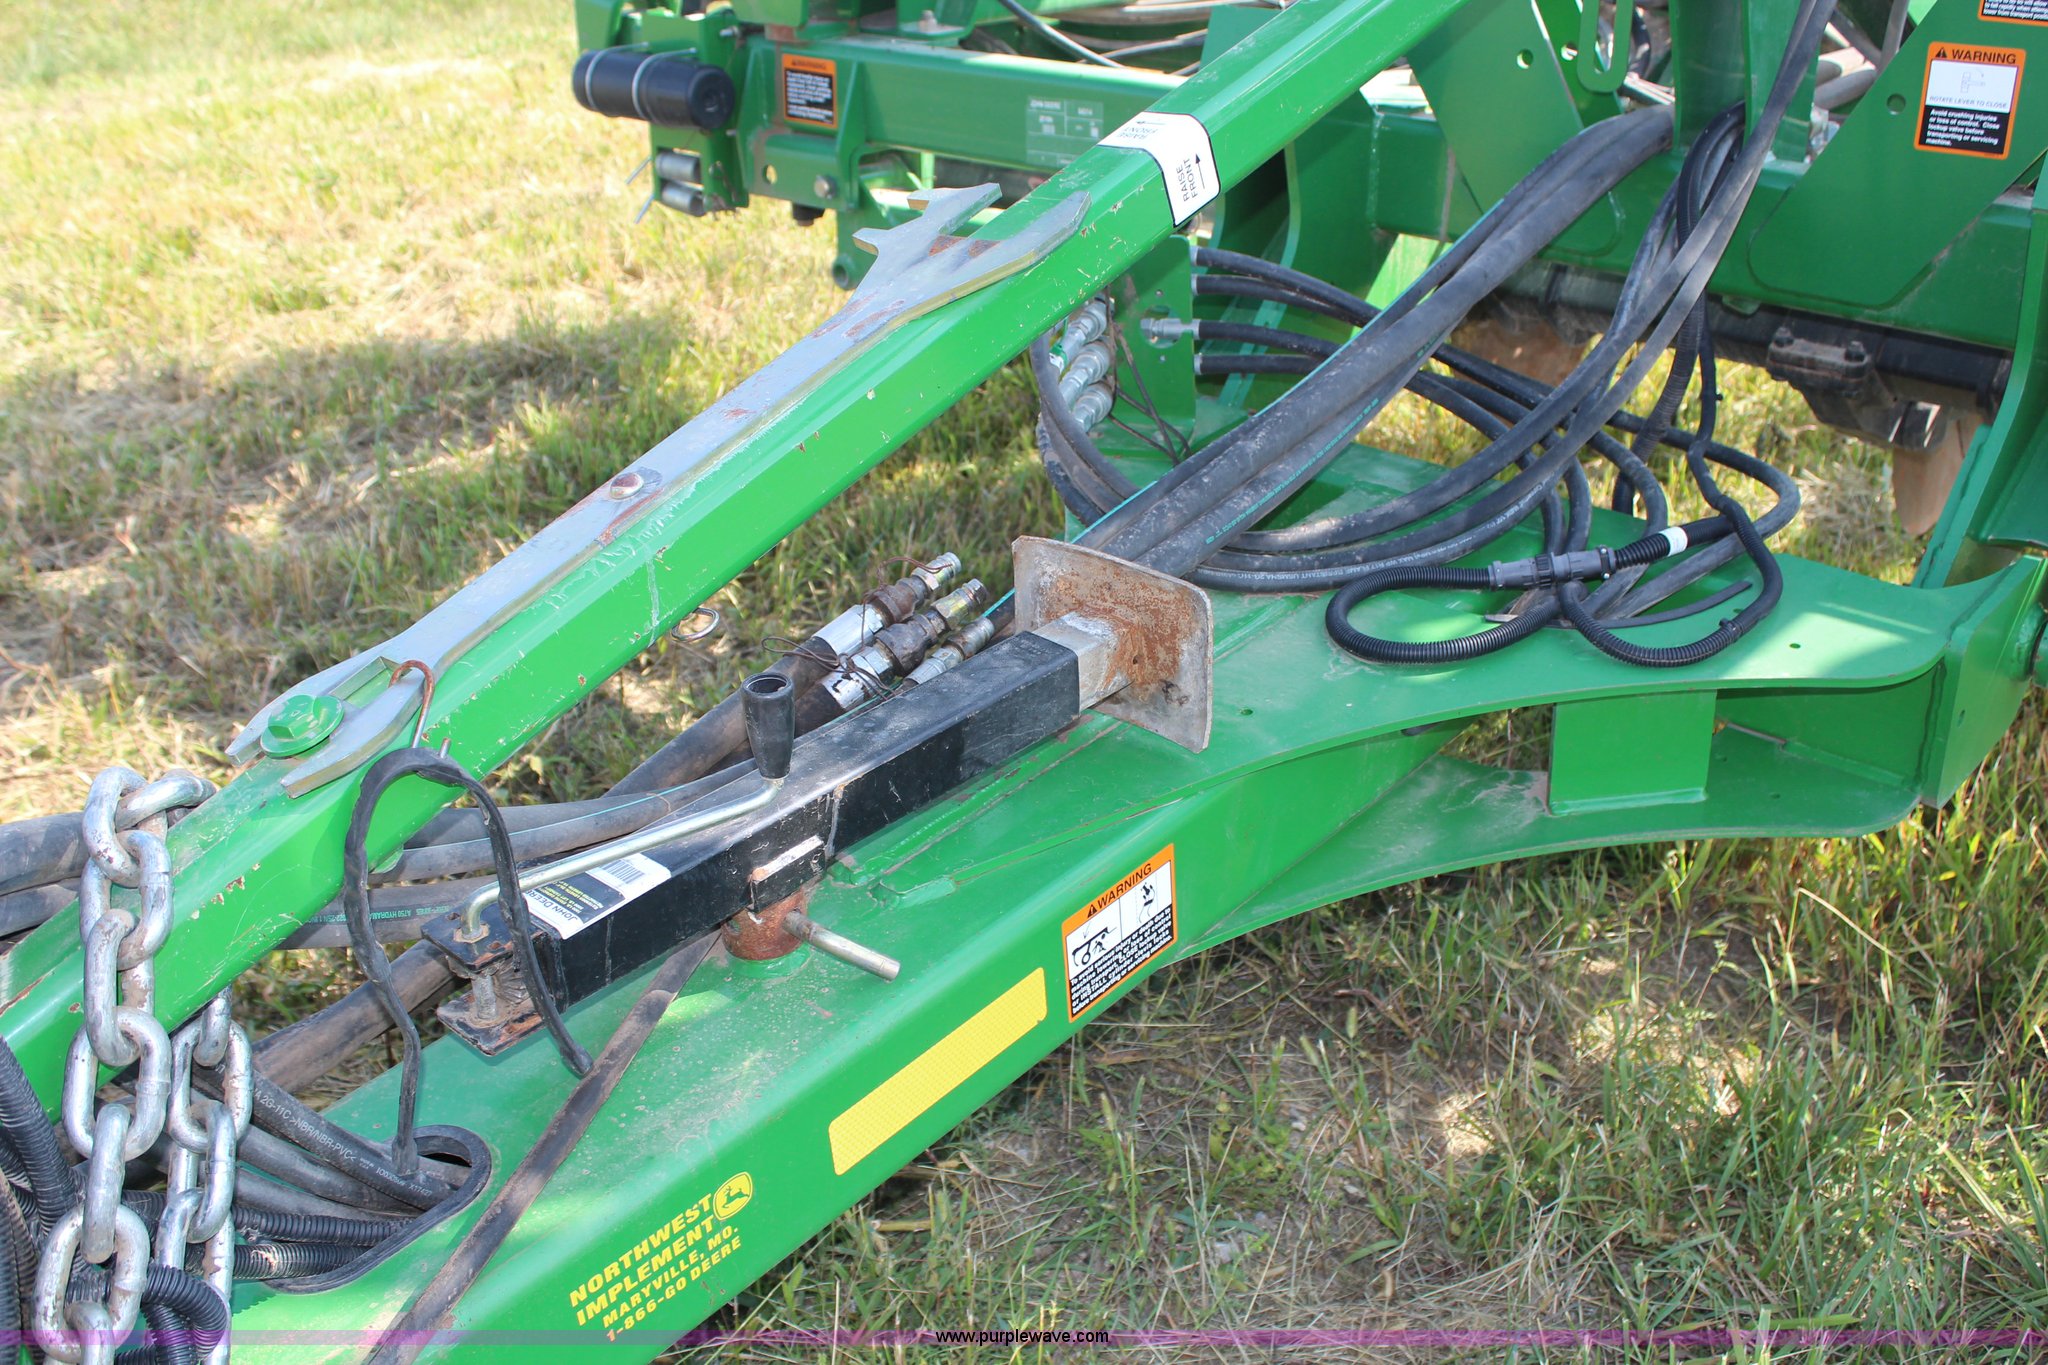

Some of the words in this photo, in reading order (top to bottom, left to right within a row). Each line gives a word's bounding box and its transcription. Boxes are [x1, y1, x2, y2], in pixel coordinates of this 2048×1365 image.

[1952, 49, 2016, 64] WARNING
[1930, 109, 1948, 117] Avoid
[1948, 110, 1975, 120] crushing
[1975, 112, 1998, 122] injuries
[1957, 119, 1981, 128] control.
[1982, 122, 2000, 130] Close
[1985, 100, 2007, 108] CLOSE
[1925, 138, 1952, 146] machine.
[1926, 130, 1963, 141] transporting
[1970, 135, 1999, 146] servicing
[1928, 123, 1948, 132] lockup
[1948, 125, 1964, 133] valve
[1965, 126, 1984, 135] before
[1176, 165, 1190, 202] RAISE
[1183, 158, 1198, 199] FRONT
[1097, 863, 1152, 909] WARNING
[551, 905, 578, 921] JOHN
[1070, 975, 1078, 987] To
[1078, 963, 1093, 981] avoid
[1094, 948, 1114, 969] serious
[1115, 935, 1131, 954] injury
[1138, 918, 1153, 935] death
[1154, 909, 1164, 923] due
[1071, 969, 1095, 994] machine
[1096, 949, 1122, 975] lowering
[1130, 933, 1143, 948] loss
[1151, 912, 1170, 933] control
[1071, 981, 1090, 1001] during
[1118, 944, 1138, 964] CLOSE
[1138, 929, 1157, 950] lockup
[1157, 919, 1171, 935] valve
[1080, 975, 1106, 1001] INSTALL
[1108, 954, 1133, 981] cylinder
[1134, 940, 1152, 959] clevis
[1153, 927, 1169, 945] locks
[1072, 996, 1089, 1014] before
[1089, 971, 1120, 1002] transporting
[1127, 949, 1150, 972] servicing
[260, 1093, 292, 1120] 2G-11C
[569, 1193, 712, 1308] NORTHWEST
[576, 1215, 715, 1327] IMPLEMENT
[602, 1249, 705, 1329] MARYVILLE,
[707, 1224, 739, 1251] MO.
[606, 1276, 687, 1343] 1-866-GO
[690, 1235, 742, 1281] DEERE
